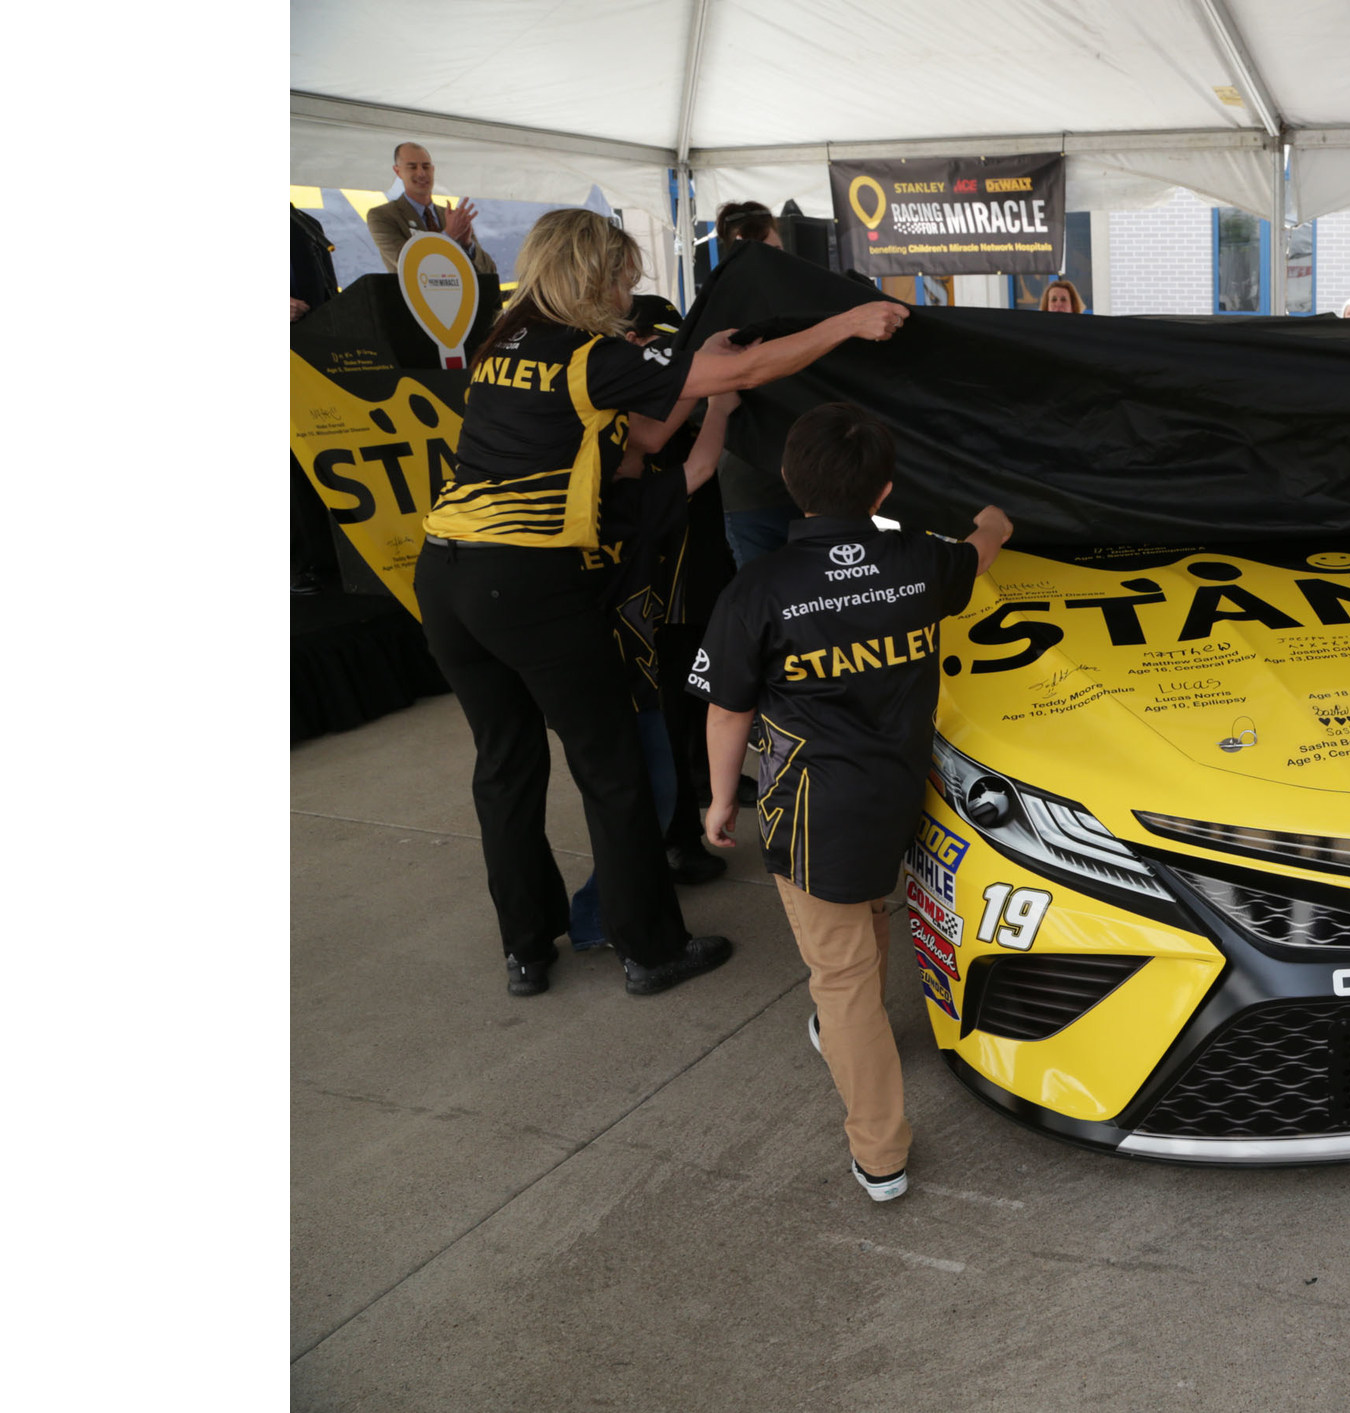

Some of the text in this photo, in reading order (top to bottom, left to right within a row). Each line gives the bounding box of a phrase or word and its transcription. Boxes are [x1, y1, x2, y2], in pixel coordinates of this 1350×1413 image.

[894, 182, 945, 194] STANLEY
[953, 179, 978, 191] ACE
[891, 202, 944, 222] RACING
[944, 200, 1048, 234] MIRACLE
[921, 224, 938, 234] FOR
[869, 242, 1052, 255] benefiting Children's Miracle Network Hospitals
[825, 564, 880, 582] TOYOTA
[782, 580, 926, 620] stanleyracing.com
[784, 623, 936, 682] STANLEY
[1142, 650, 1239, 668] Matthew Garland
[1290, 648, 1330, 656] Joseph
[1174, 660, 1224, 672] Cerebral
[1227, 653, 1257, 665] Palsy
[688, 673, 710, 692] OTA
[1002, 713, 1026, 721] Age
[1050, 687, 1136, 714] Hydrocephalus
[1032, 682, 1104, 709] Teddy Moore
[1155, 690, 1232, 703] Lucas Norris
[1300, 740, 1338, 754] Sasha
[1287, 756, 1312, 767] Age
[1314, 754, 1326, 762] 9,
[907, 880, 945, 922] COMP
[976, 882, 1053, 951] 19
[932, 918, 954, 939] CAMS
[910, 918, 956, 971] Edelbrock
[920, 970, 952, 1002] SUNOCO
